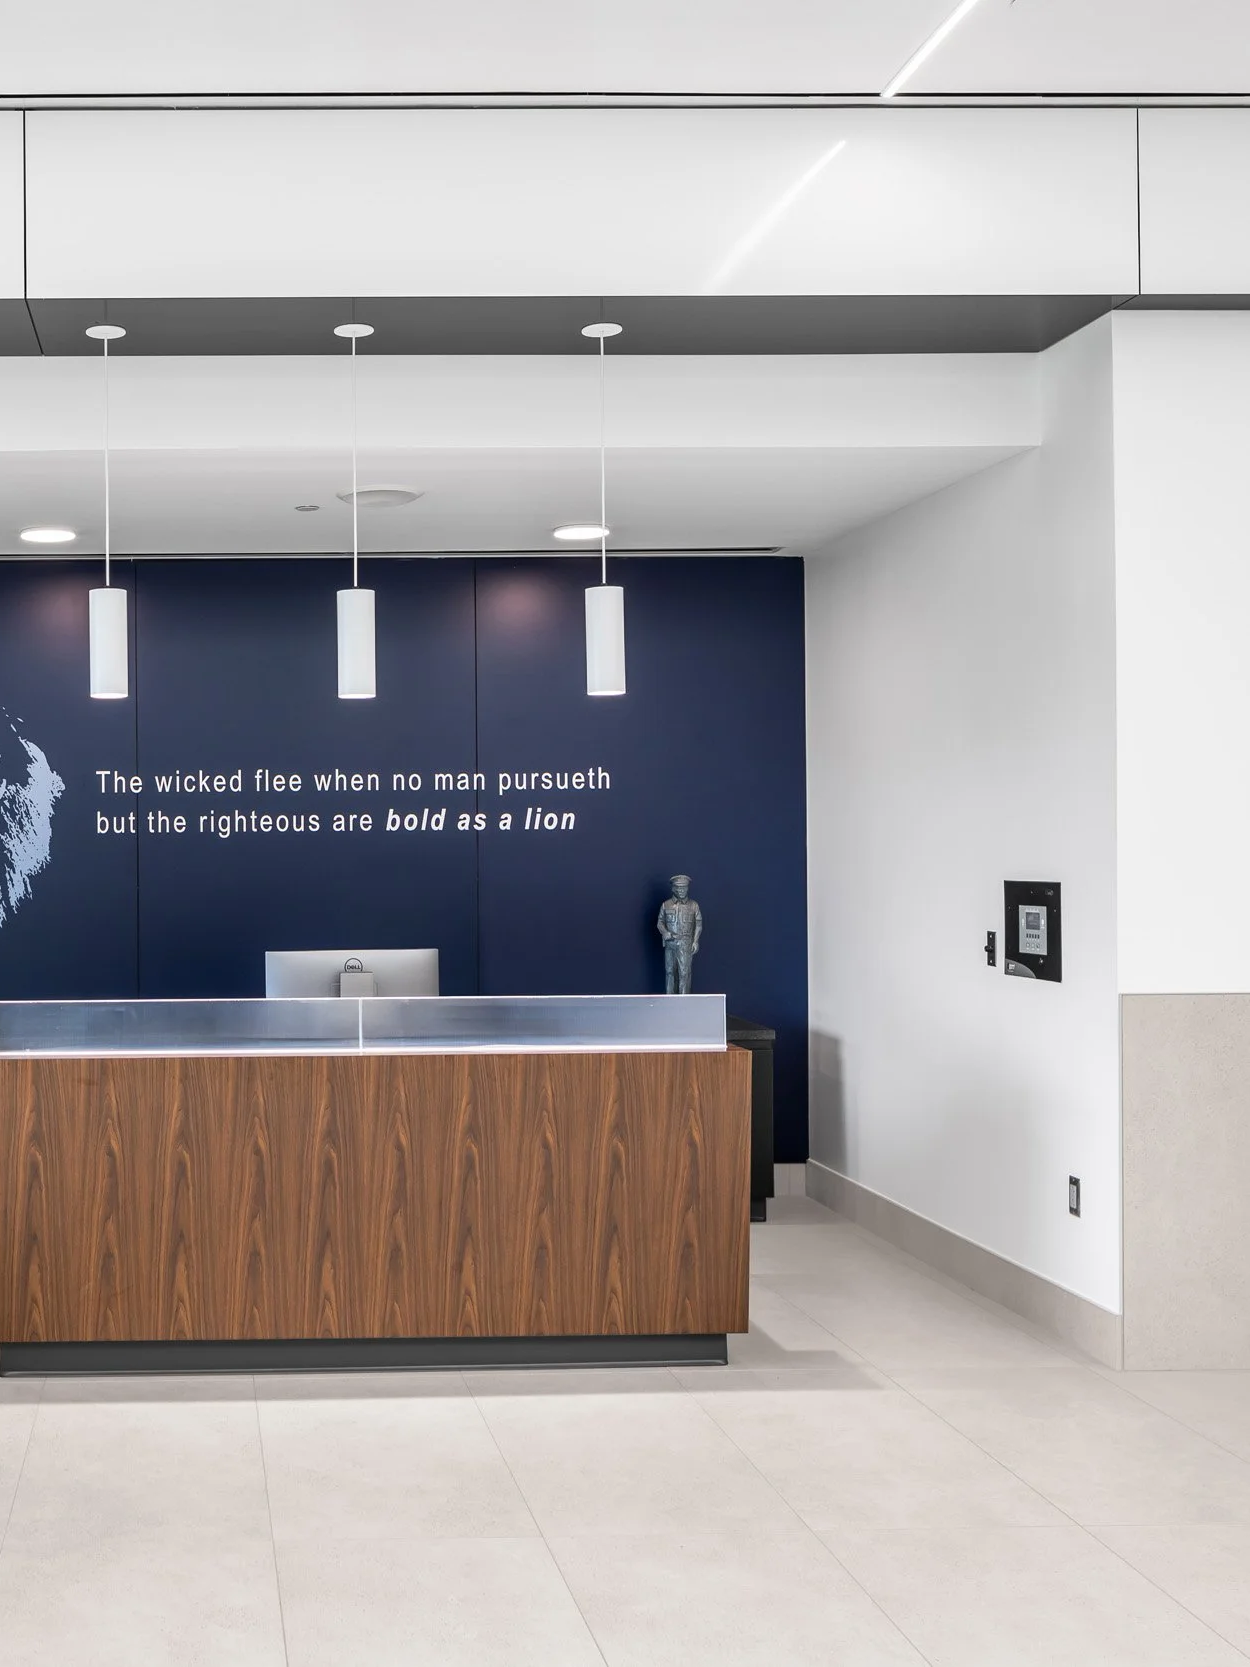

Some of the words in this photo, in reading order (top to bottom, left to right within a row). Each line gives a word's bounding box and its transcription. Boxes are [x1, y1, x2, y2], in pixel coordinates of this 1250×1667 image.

[95, 770, 143, 794] The
[154, 769, 242, 793] wicked
[254, 768, 302, 792] flee
[313, 768, 380, 792] when
[392, 773, 422, 791] no
[434, 772, 486, 791] man
[498, 766, 610, 796] pursueth
[96, 810, 136, 834] but
[147, 810, 187, 834] the
[199, 809, 320, 839] righteous
[332, 813, 373, 832] are
[385, 807, 447, 832] bold
[457, 813, 487, 831] as
[498, 812, 513, 831] a
[524, 807, 576, 831] lion
